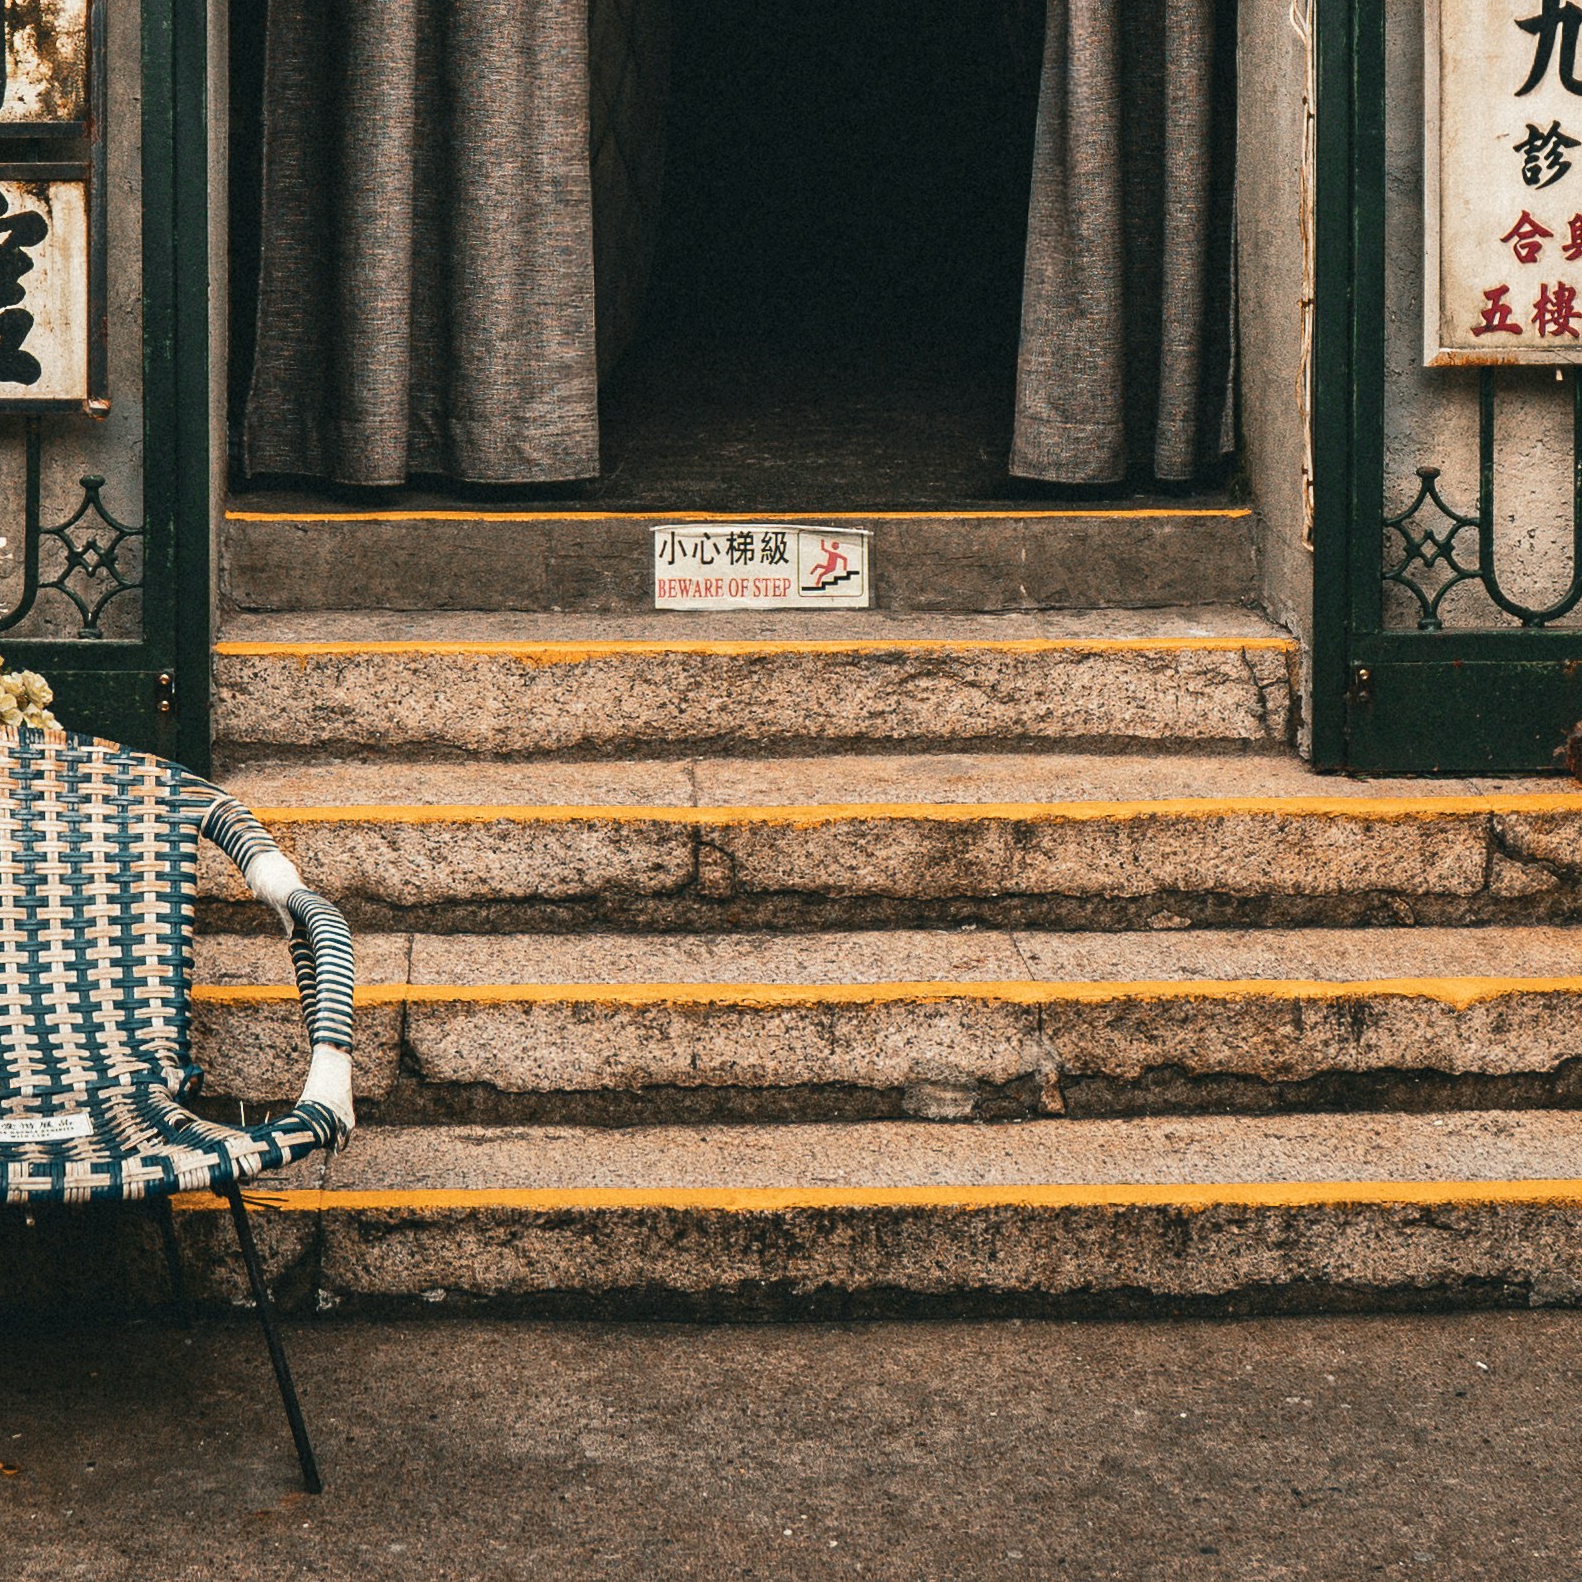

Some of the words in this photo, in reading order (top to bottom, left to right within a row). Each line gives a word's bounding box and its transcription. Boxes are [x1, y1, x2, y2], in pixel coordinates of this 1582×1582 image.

[658, 530, 790, 566] 小心梯級
[657, 577, 725, 599] BEWARE
[727, 577, 749, 599] OF
[752, 576, 792, 599] STEP
